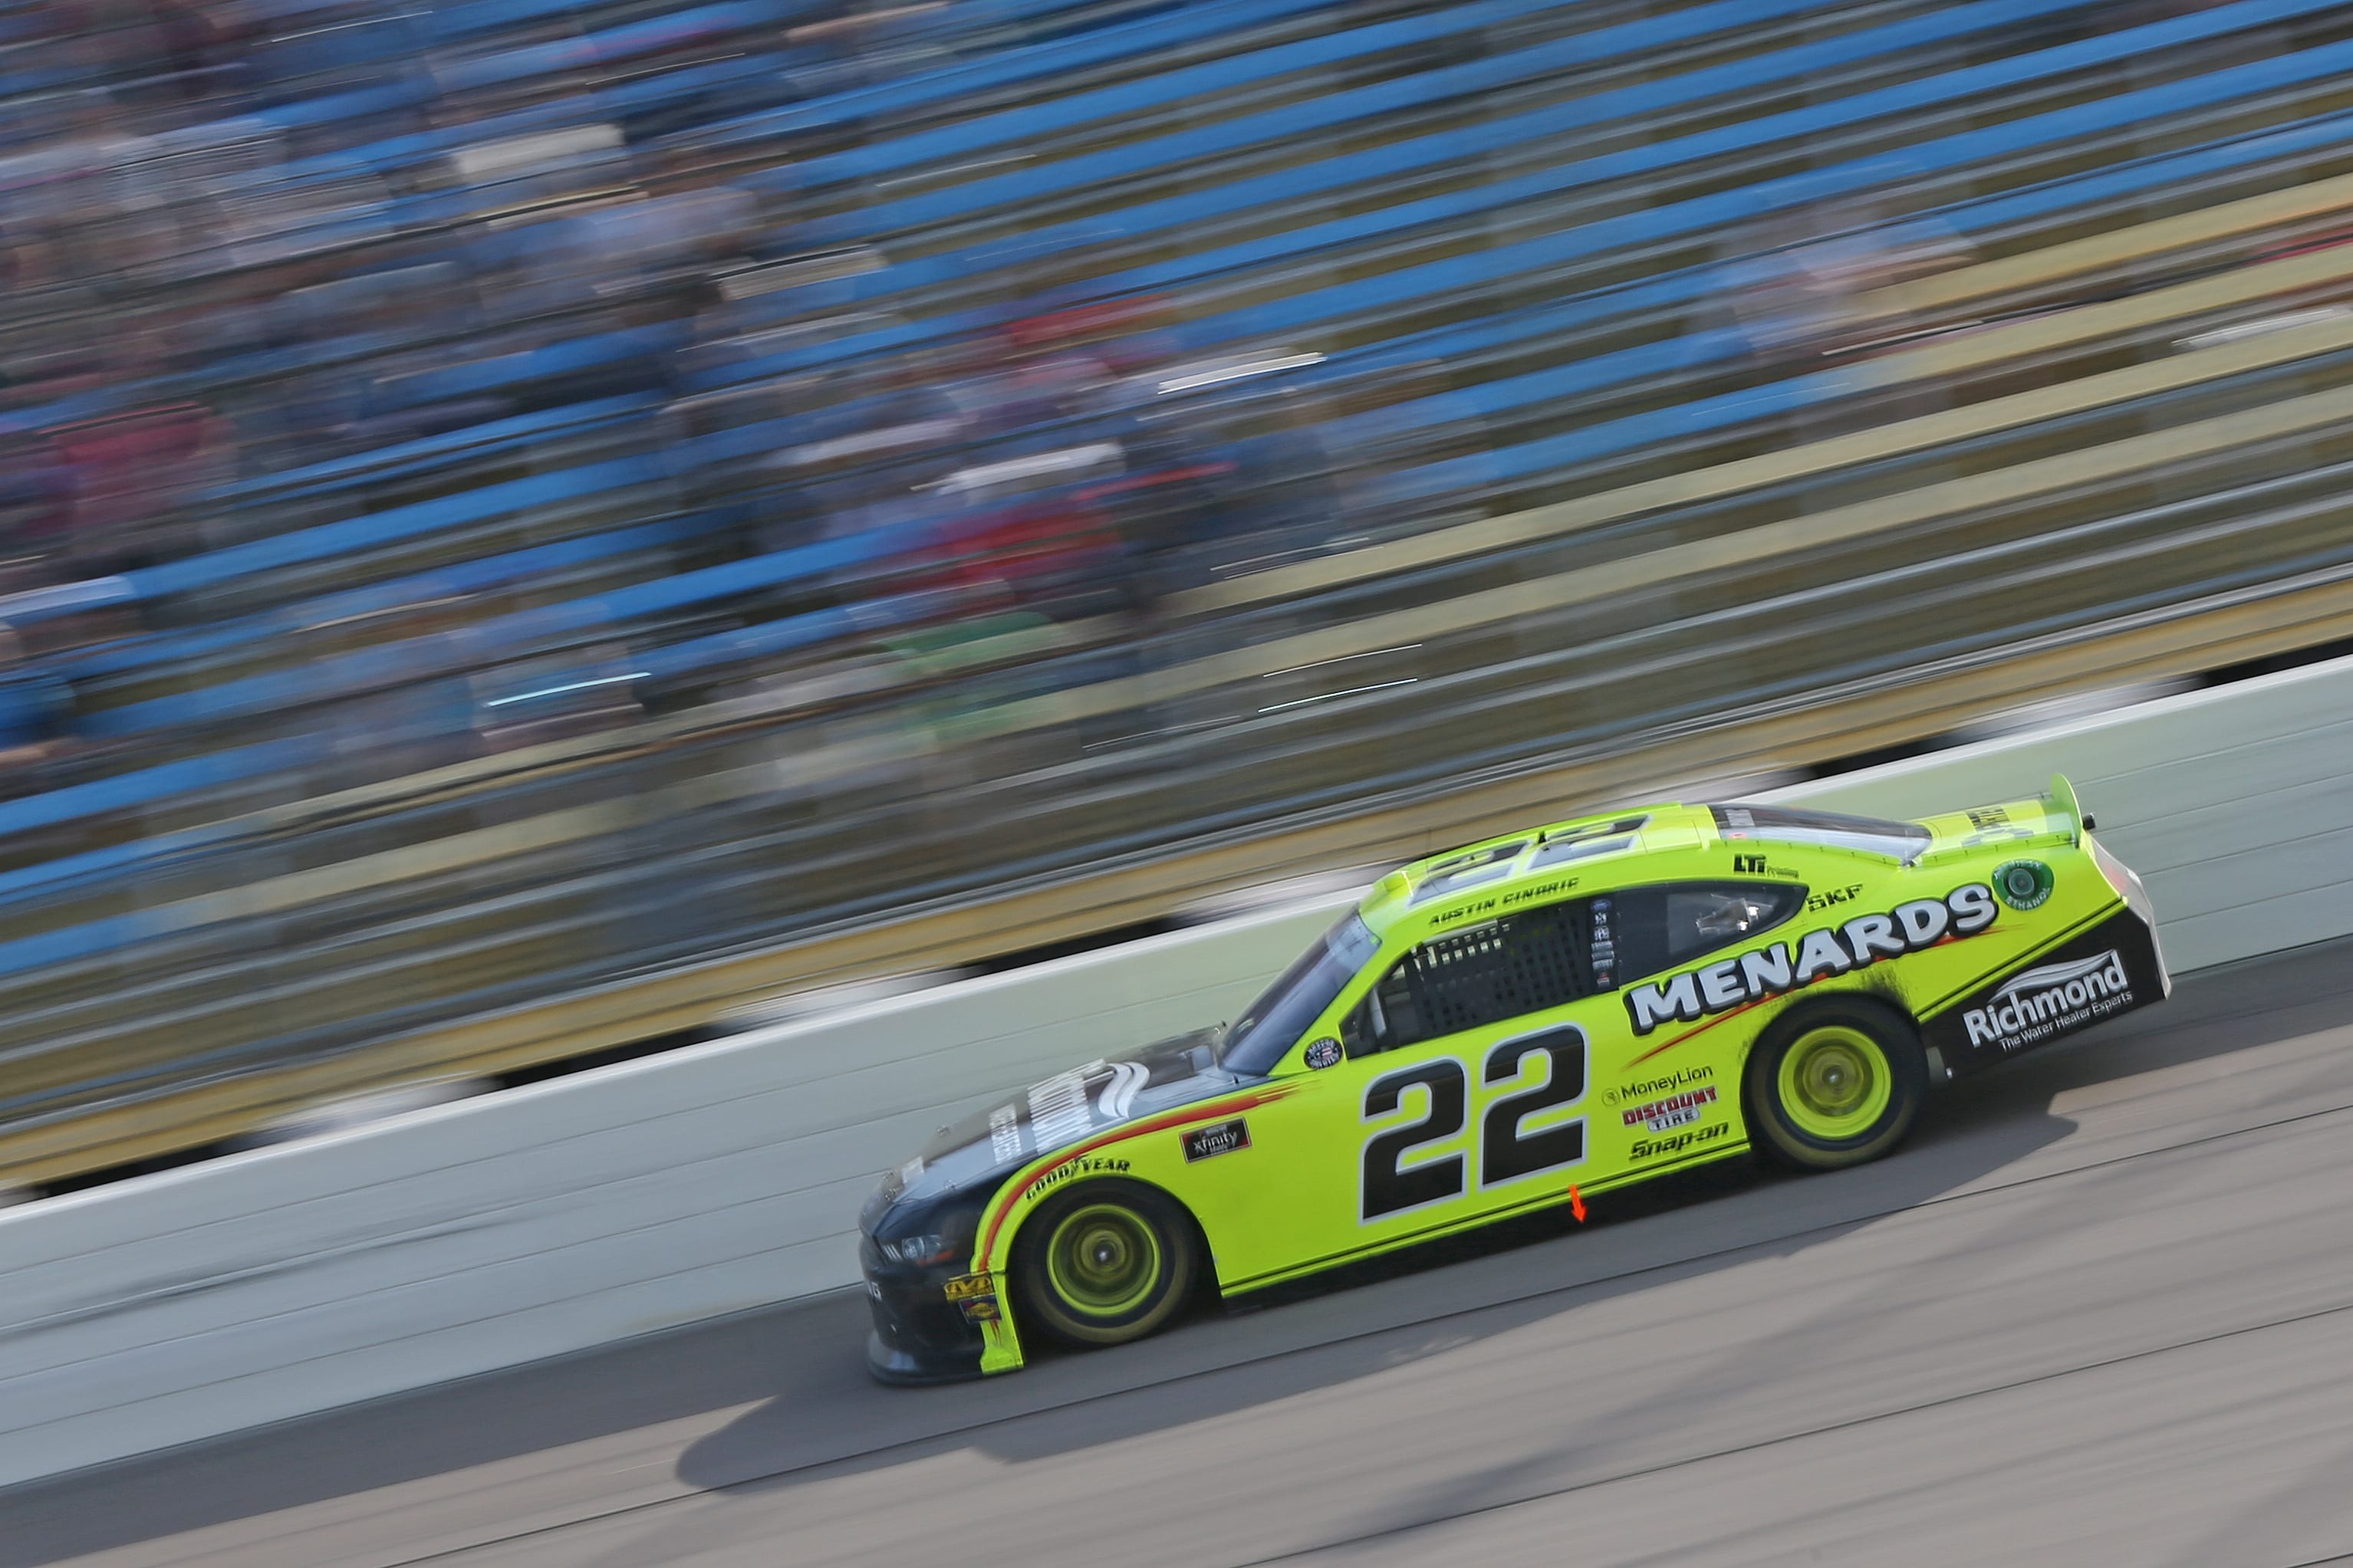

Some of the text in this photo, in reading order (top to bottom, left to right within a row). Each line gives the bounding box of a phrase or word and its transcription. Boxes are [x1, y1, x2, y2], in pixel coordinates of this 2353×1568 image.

[1429, 876, 1579, 925] AUSTIN CINDRIC
[1805, 883, 1863, 912] SKF
[2005, 886, 2051, 911] ETHANOL
[1625, 883, 1997, 1033] MENARDS
[1963, 949, 2128, 1048] Richmond
[1999, 990, 2134, 1051] The Water Heater Experts
[1621, 1066, 1713, 1100] MoneyLion
[1359, 1022, 1588, 1226] 22
[1622, 1085, 1717, 1126] DISCOUNT
[1651, 1111, 1695, 1131] TIRE
[1193, 1132, 1238, 1154] xfinity
[1629, 1122, 1729, 1160] Snap-on
[1025, 1153, 1131, 1200] GOODYEAR
